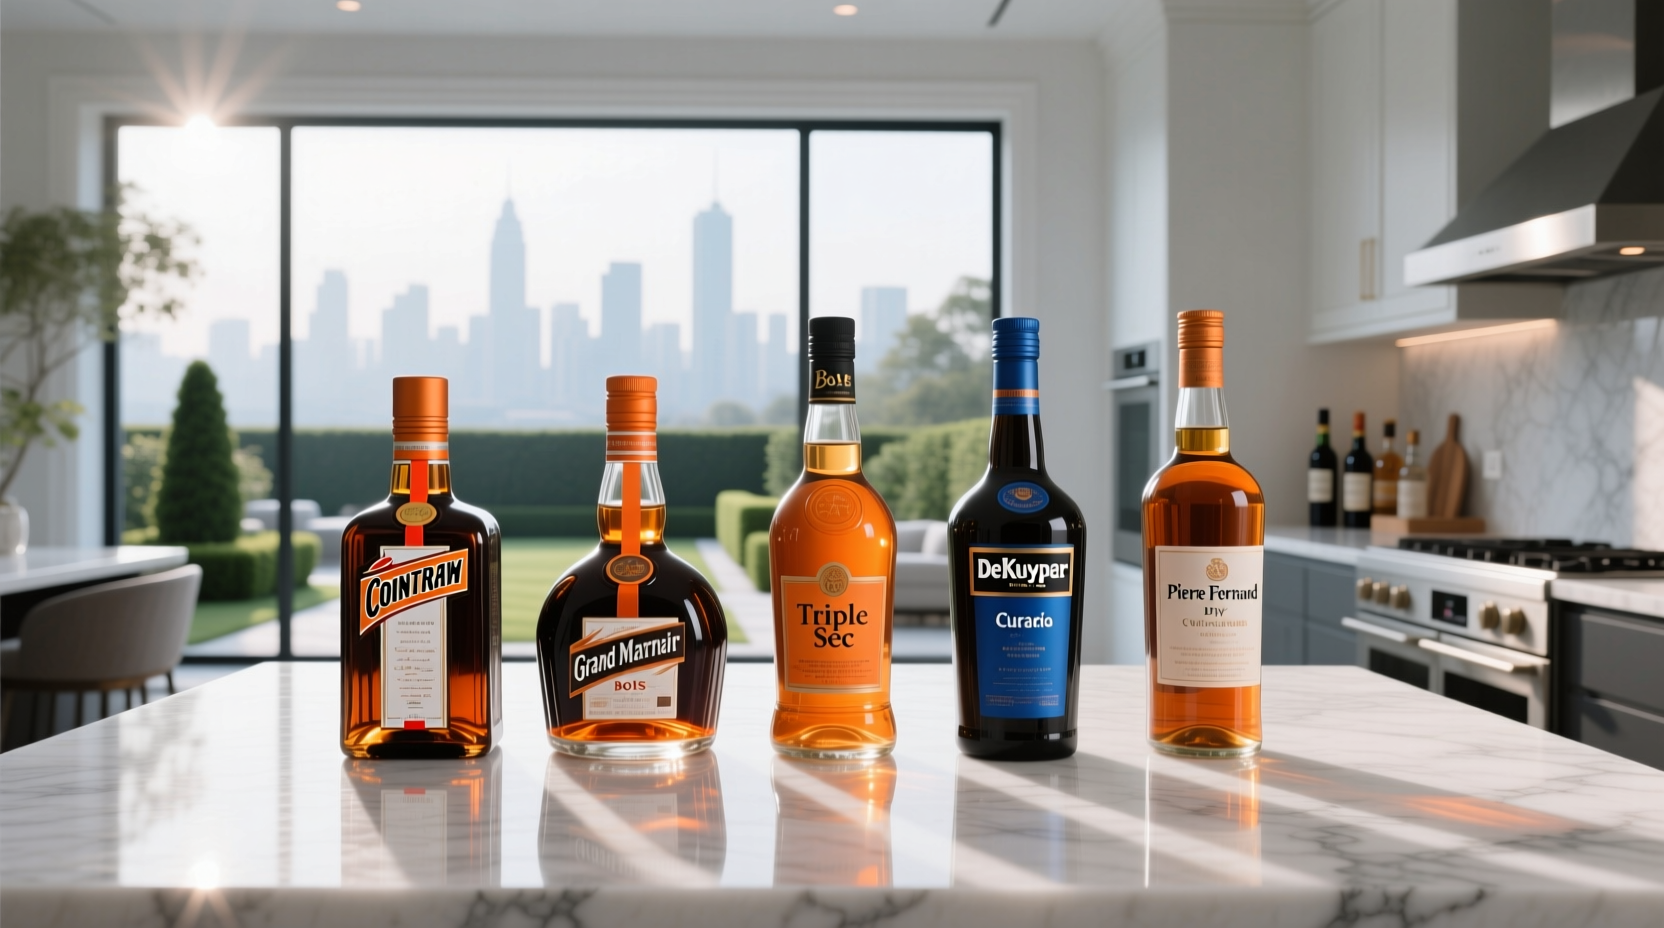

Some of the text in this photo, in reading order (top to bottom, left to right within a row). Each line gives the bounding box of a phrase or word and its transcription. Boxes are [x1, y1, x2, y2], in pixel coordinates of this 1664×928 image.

[977, 557, 1069, 584] DeKuypar
[796, 603, 868, 631] Triple
[814, 627, 854, 648] Sec
[574, 645, 616, 682] Grand
